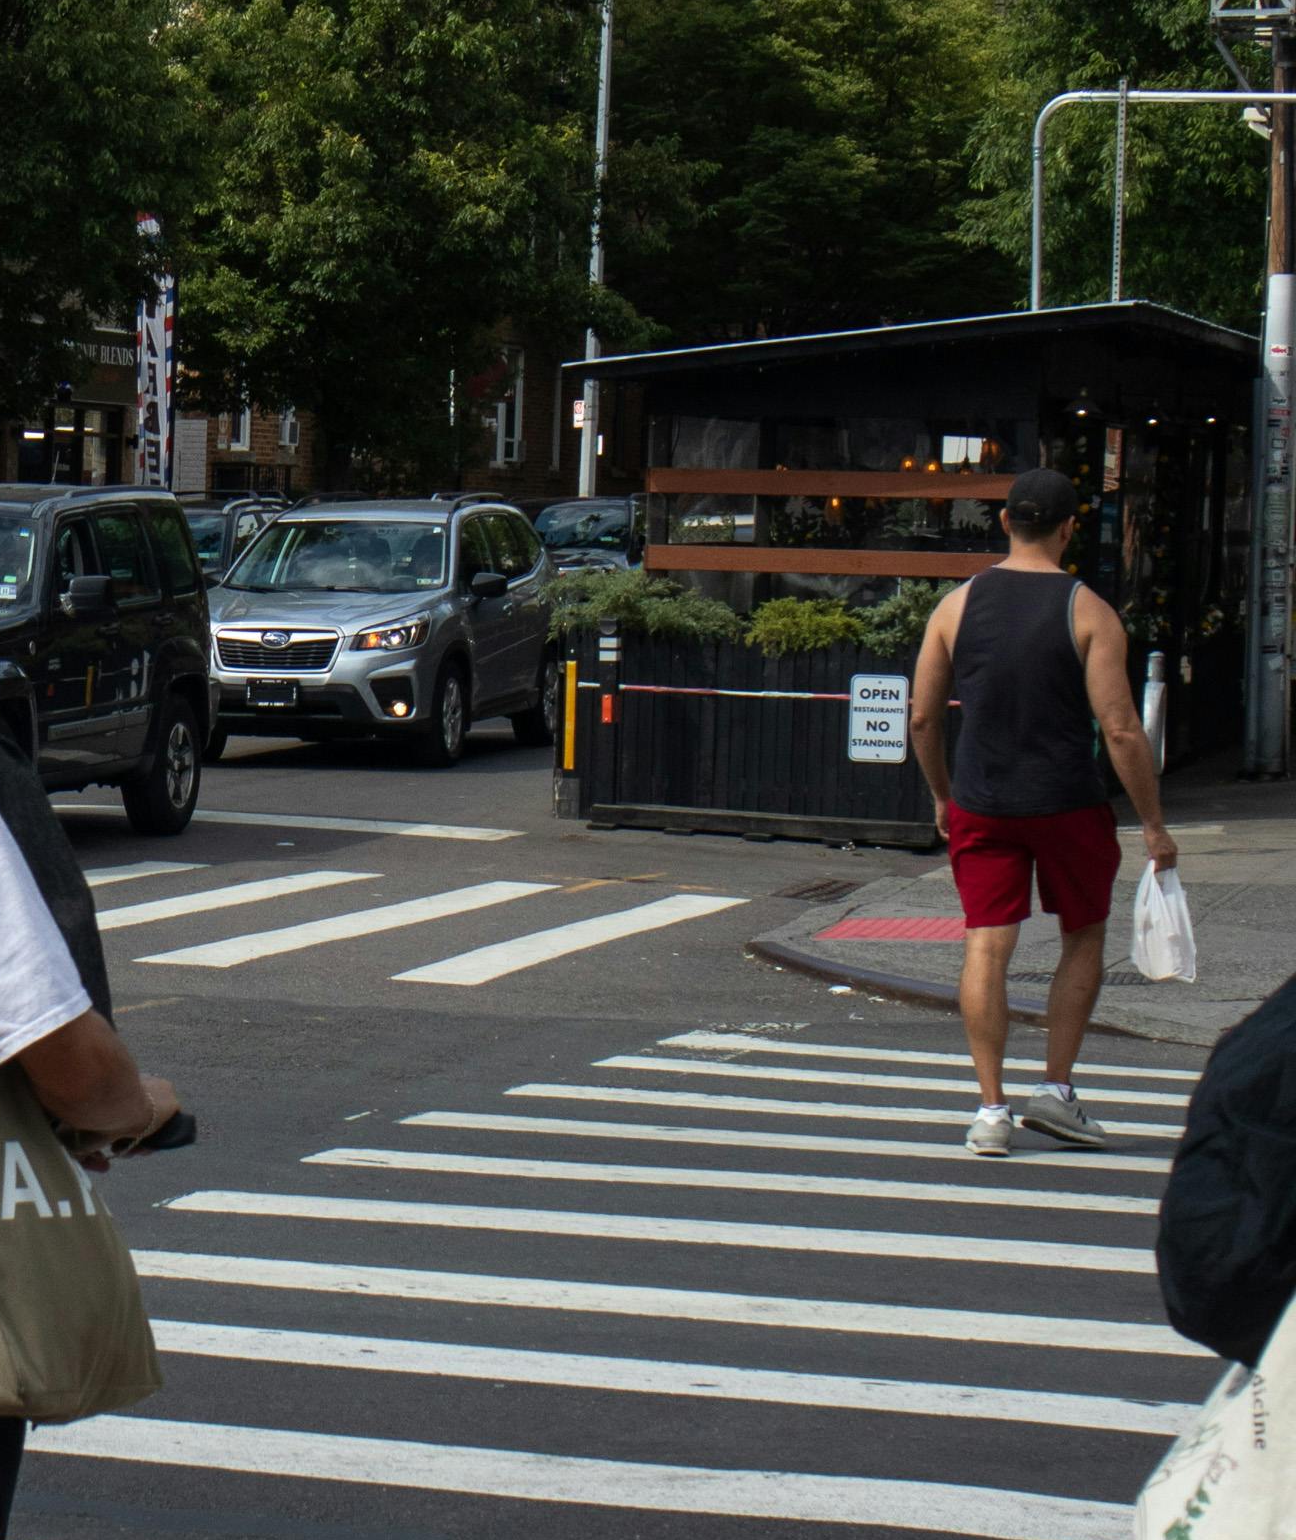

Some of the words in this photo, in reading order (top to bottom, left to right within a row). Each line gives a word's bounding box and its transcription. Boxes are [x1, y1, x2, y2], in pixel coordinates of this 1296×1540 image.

[101, 345, 135, 366] BLENDS
[860, 688, 900, 701] OPEN
[853, 706, 905, 714] RESTAURANTS
[866, 720, 890, 732] NO
[851, 738, 904, 749] STANDING
